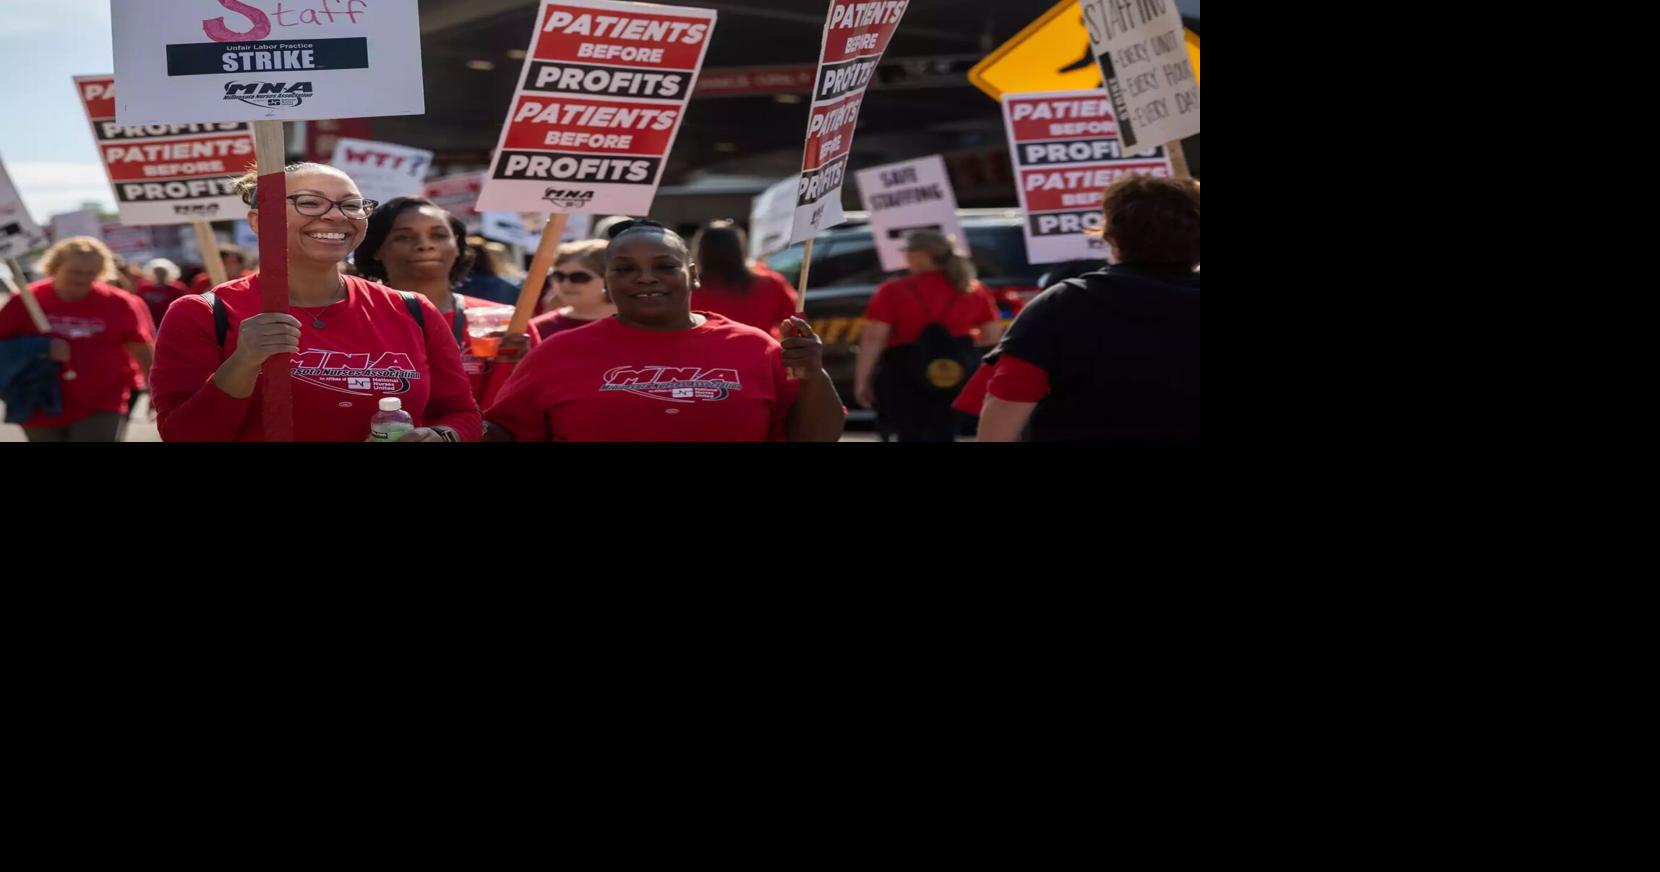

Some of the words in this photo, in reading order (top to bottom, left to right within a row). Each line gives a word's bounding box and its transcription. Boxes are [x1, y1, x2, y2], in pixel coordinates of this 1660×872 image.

[202, 0, 367, 42] Staff
[830, 1, 905, 29] PATIENTS
[544, 11, 708, 44] PATIENTS
[222, 50, 316, 72] STRIKE
[577, 43, 665, 63] BEFORE
[225, 82, 313, 94] MNA
[535, 65, 682, 96] PROFITS
[514, 102, 677, 131] PATIENTS
[1013, 100, 1114, 121] PATIEN
[1050, 121, 1117, 135] BEFOR
[107, 138, 252, 164] PATIENTS
[544, 131, 633, 149] BEFORE
[1025, 141, 1157, 163] PROFI
[143, 160, 225, 176] BEFORE
[504, 155, 651, 182] PROFITS
[122, 178, 236, 200] PROFIT
[1061, 192, 1104, 206] BEF
